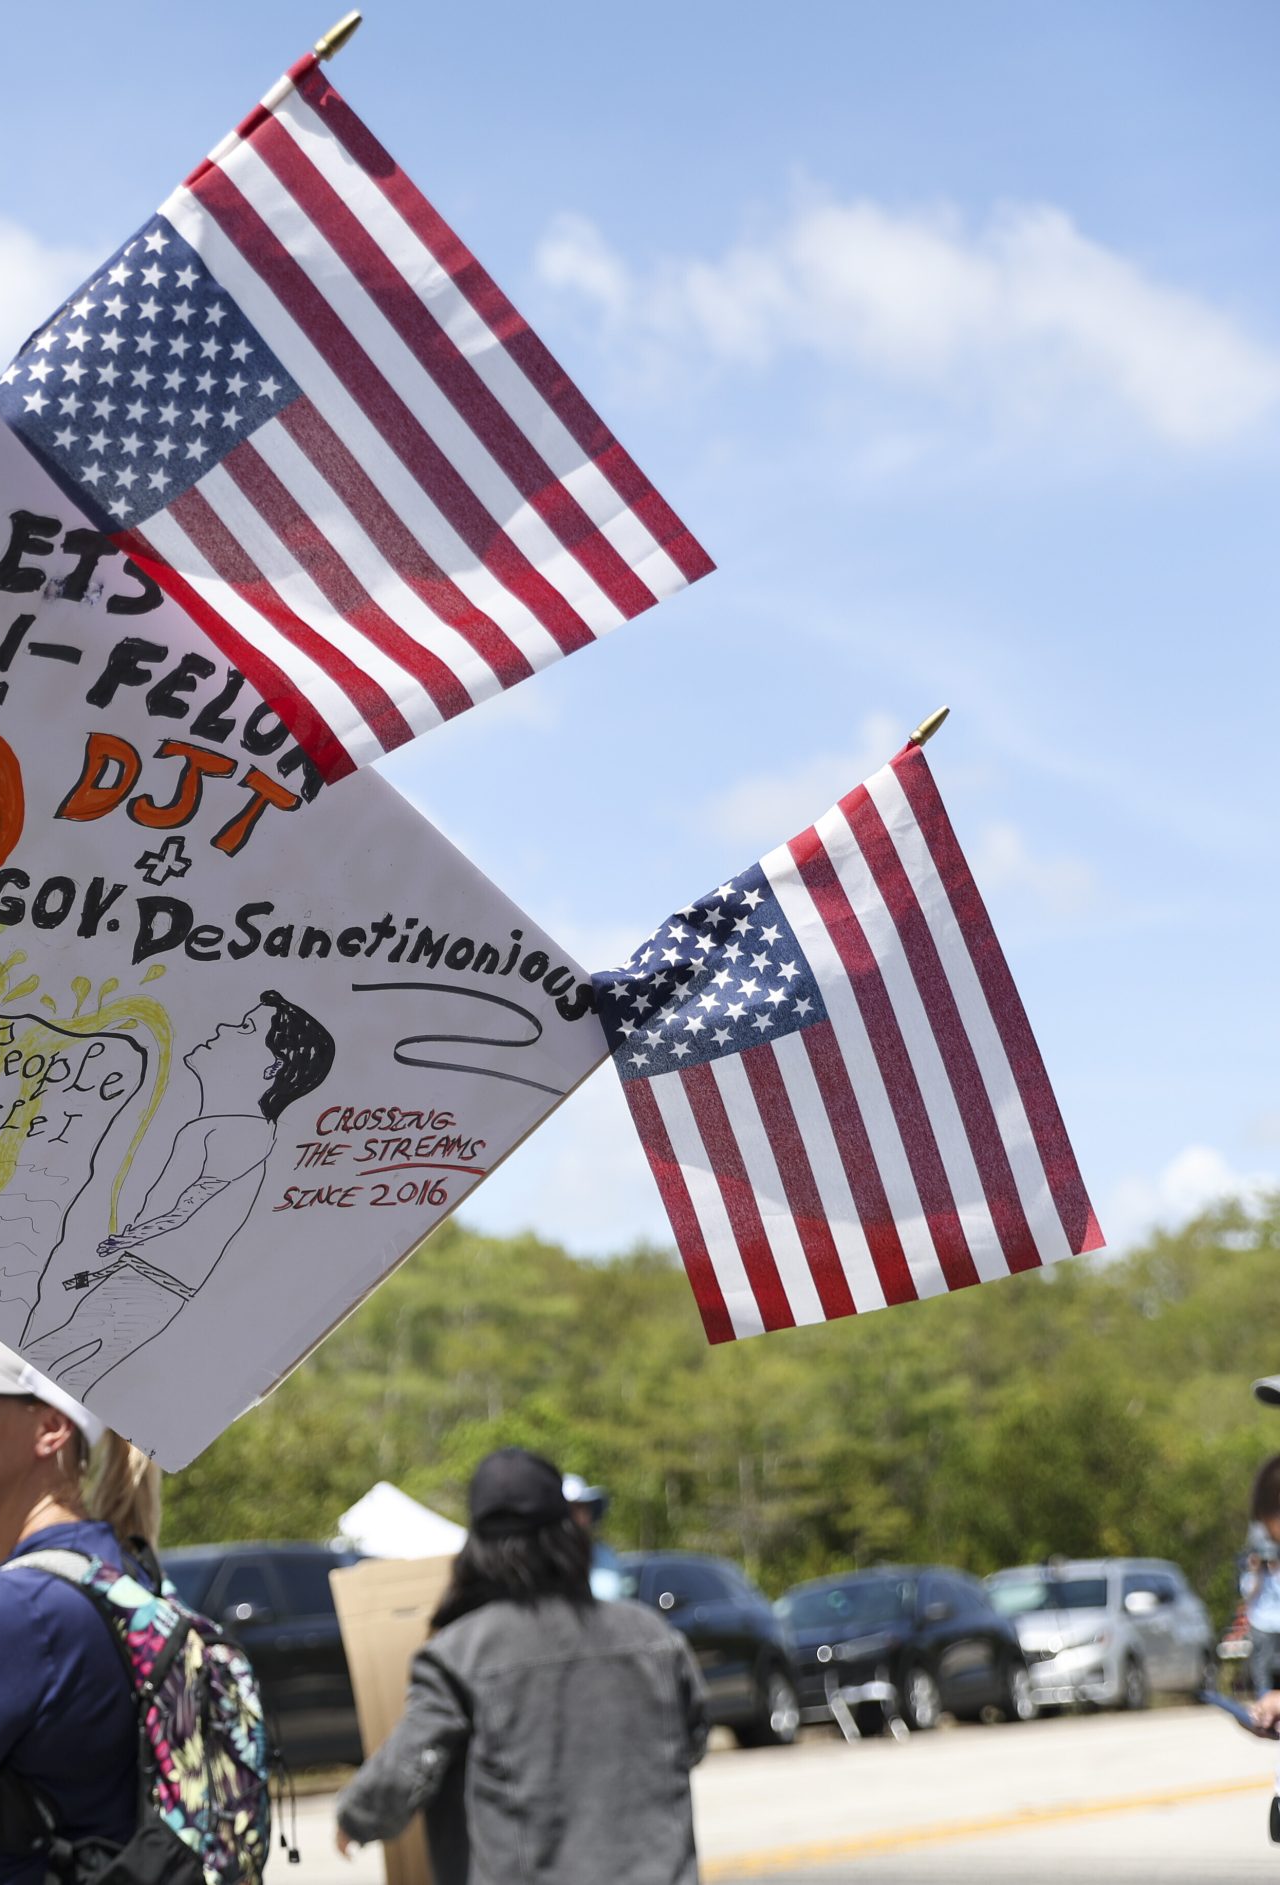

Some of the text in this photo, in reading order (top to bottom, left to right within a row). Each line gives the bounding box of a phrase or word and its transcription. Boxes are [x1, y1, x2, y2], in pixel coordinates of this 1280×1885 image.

[54, 732, 303, 858] DJT
[316, 1105, 456, 1136] CROSSING
[293, 1134, 486, 1171] THE STREAMS
[272, 1177, 448, 1212] SINCE 2016
